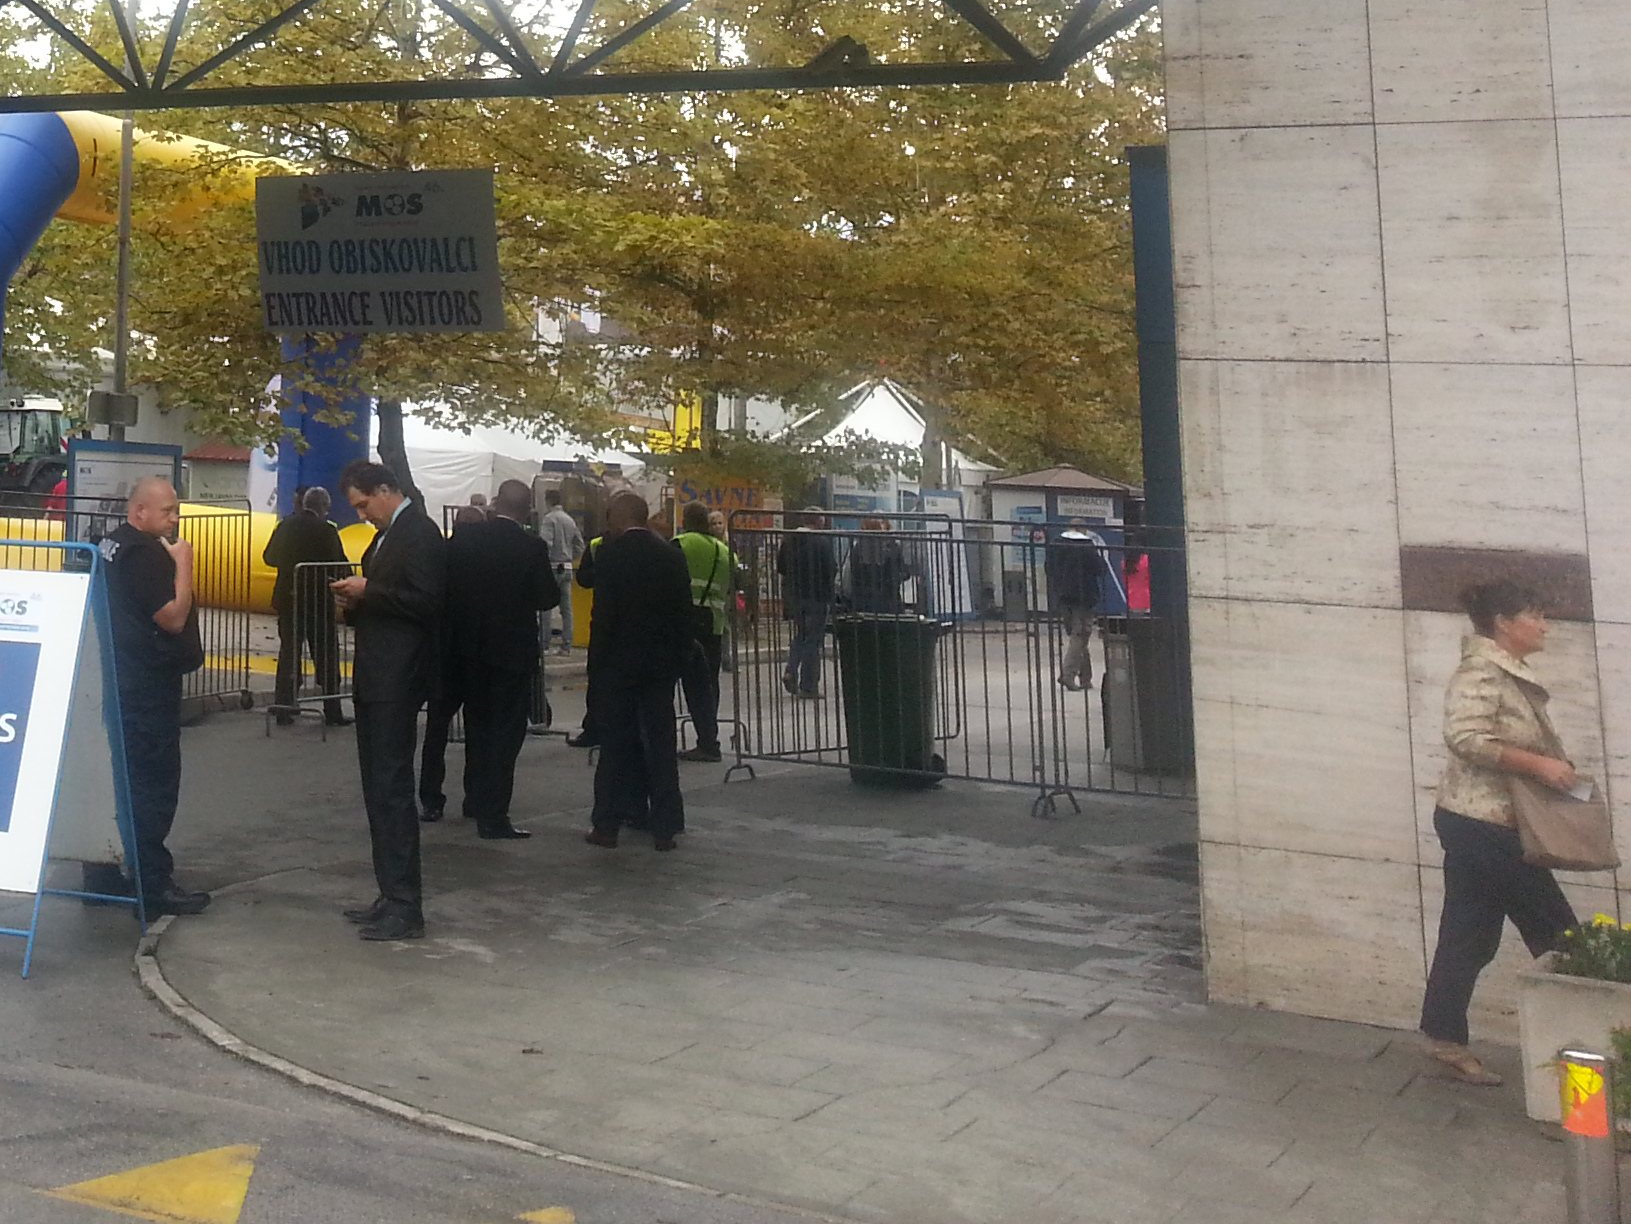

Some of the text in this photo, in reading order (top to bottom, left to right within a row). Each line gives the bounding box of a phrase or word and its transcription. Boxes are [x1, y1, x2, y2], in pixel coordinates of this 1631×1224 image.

[262, 237, 478, 276] VHOD OBISKOVALCI
[265, 290, 483, 327] ENTRANCE VISITORS
